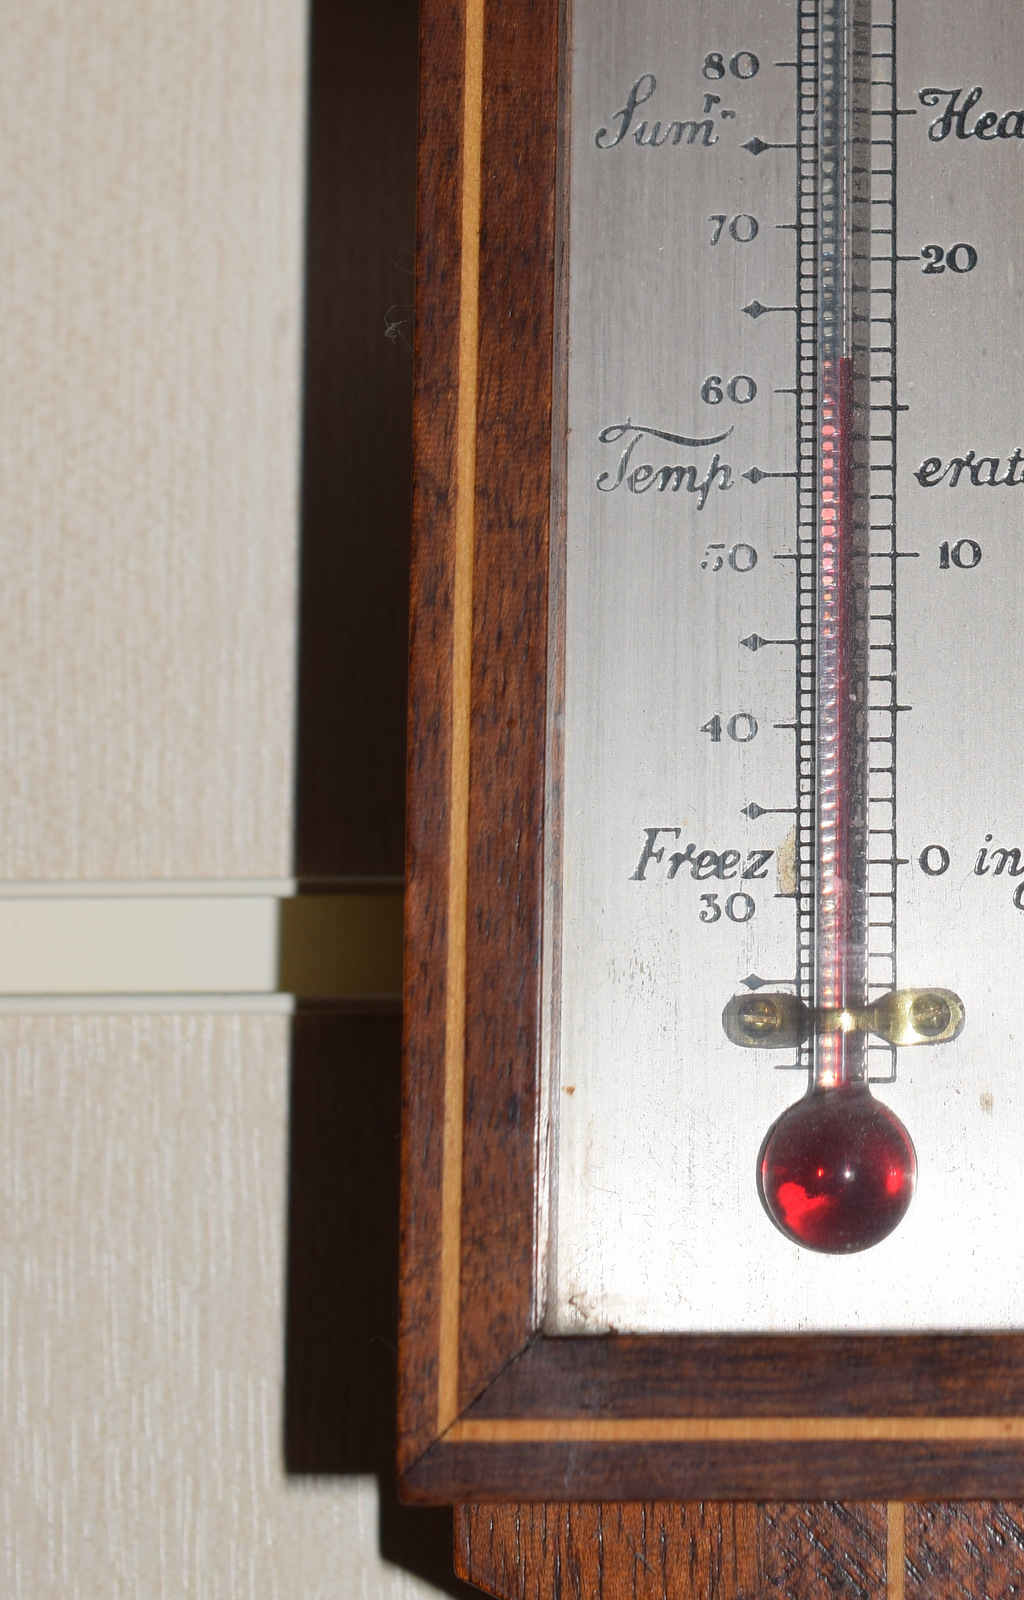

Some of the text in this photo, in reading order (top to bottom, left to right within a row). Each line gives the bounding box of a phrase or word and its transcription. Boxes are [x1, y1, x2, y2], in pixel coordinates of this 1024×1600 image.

[701, 51, 760, 80] 80
[708, 213, 760, 246] 70
[920, 243, 978, 275] 20
[700, 375, 758, 406] 60
[596, 416, 735, 511] Temp
[700, 543, 758, 572] 50
[939, 538, 982, 569] 10
[699, 712, 758, 743] 40
[628, 826, 776, 881] Freez
[699, 892, 756, 923] 30
